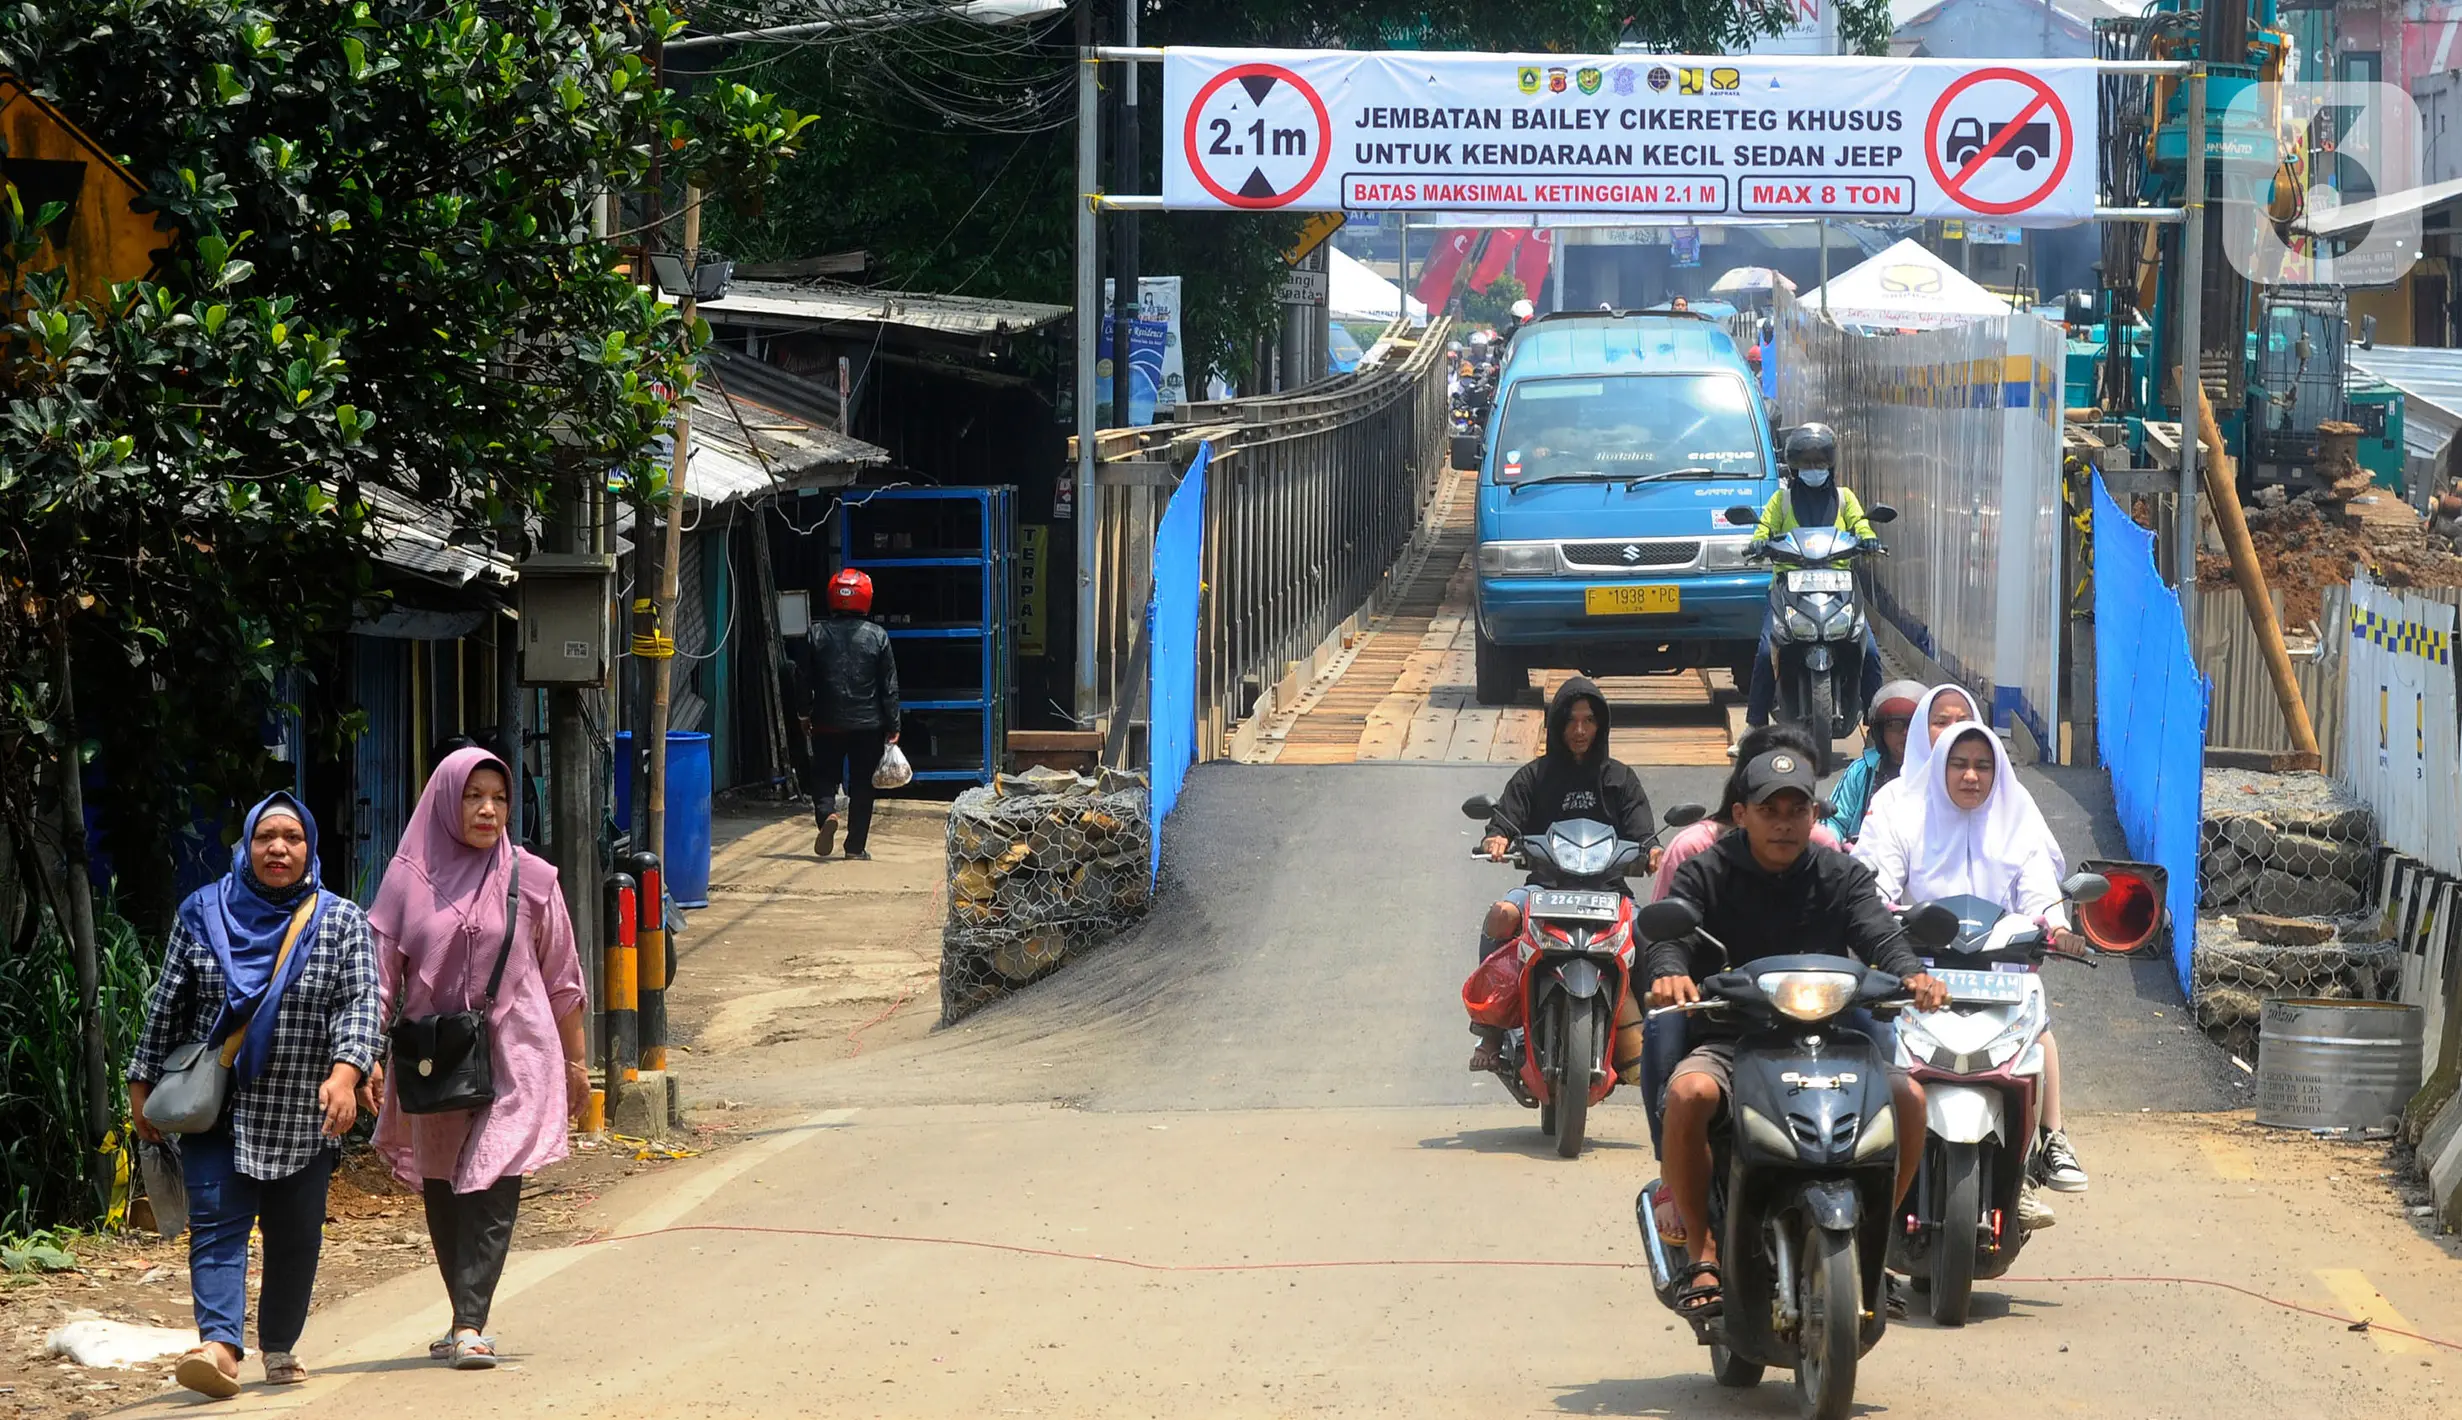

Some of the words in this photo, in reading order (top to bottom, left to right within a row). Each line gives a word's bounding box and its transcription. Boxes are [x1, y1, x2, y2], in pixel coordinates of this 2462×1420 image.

[1355, 107, 1501, 130] JEMBATAN
[1512, 108, 1610, 131] BAILEY
[1619, 108, 1777, 131] CIKERETEG
[1787, 110, 1904, 132] KHUSUS
[1208, 118, 1307, 156] 2.1m
[1355, 143, 1453, 165] UNTUK
[1462, 144, 1634, 166] KENDARAAN
[1643, 144, 1724, 167] KECIL
[1733, 145, 1825, 167] SEDAN
[1834, 146, 1904, 168] JEEP
[1354, 183, 1418, 202] BATAS
[1423, 184, 1529, 203] MAKSIMAL
[1535, 184, 1659, 204] KETINGGIAN
[1665, 185, 1693, 203] 2.1
[1699, 185, 1716, 203] M
[1753, 185, 1813, 204] MAX
[1821, 185, 1837, 204] 8
[1846, 185, 1902, 204] TON
[1020, 528, 1037, 636] TERPAL
[1588, 590, 1596, 605] F
[1614, 588, 1645, 605] 1938
[1660, 588, 1676, 603] PC
